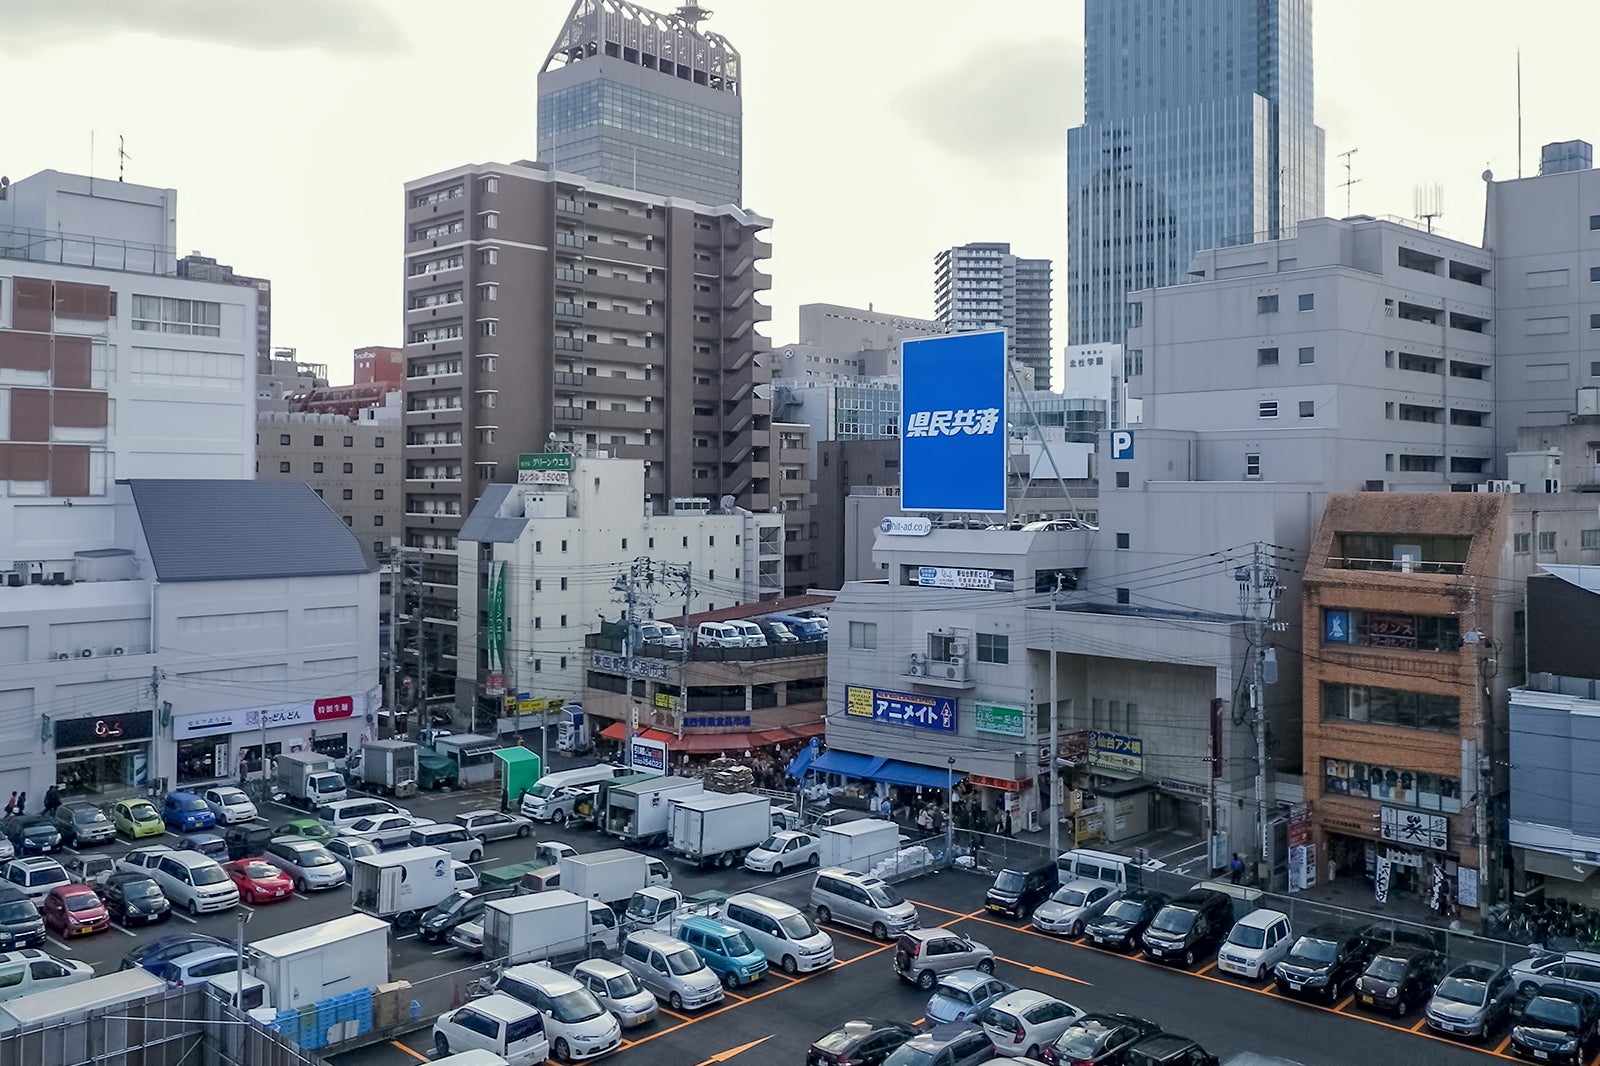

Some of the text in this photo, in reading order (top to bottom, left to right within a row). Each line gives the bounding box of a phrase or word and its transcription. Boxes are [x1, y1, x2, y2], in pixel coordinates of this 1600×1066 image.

[906, 408, 999, 437] 県民共済
[1114, 432, 1132, 456] P
[876, 700, 939, 724] アニメイト
[1097, 735, 1141, 754] 仙台アメ横
